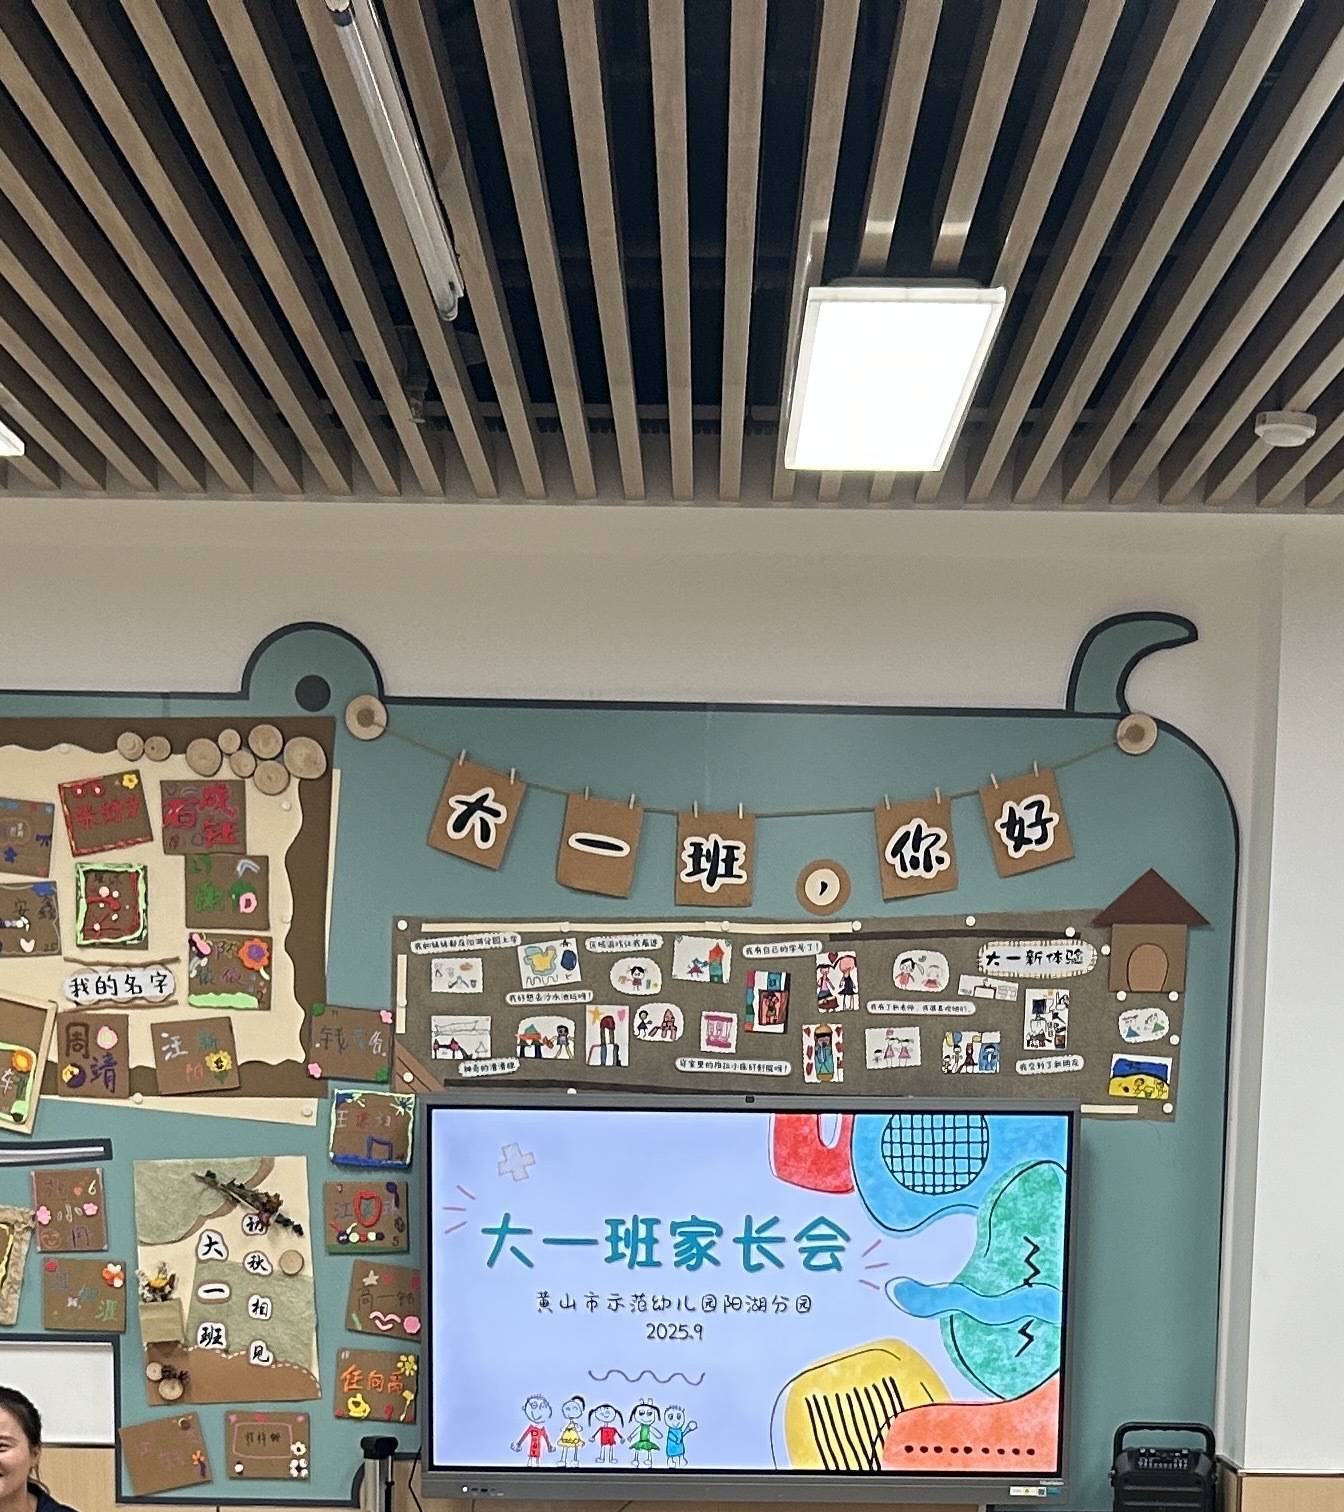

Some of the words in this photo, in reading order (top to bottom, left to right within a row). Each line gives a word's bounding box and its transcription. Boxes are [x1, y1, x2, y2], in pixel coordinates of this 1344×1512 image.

[986, 949, 1083, 966] 大一新体验
[69, 972, 167, 997] 我的名字
[481, 1213, 851, 1273] 大一班家长会
[200, 1235, 224, 1347] 大一班
[535, 1291, 812, 1315] 黄山市示范幼儿园阳湖分园
[646, 1323, 704, 1341] 2025.9
